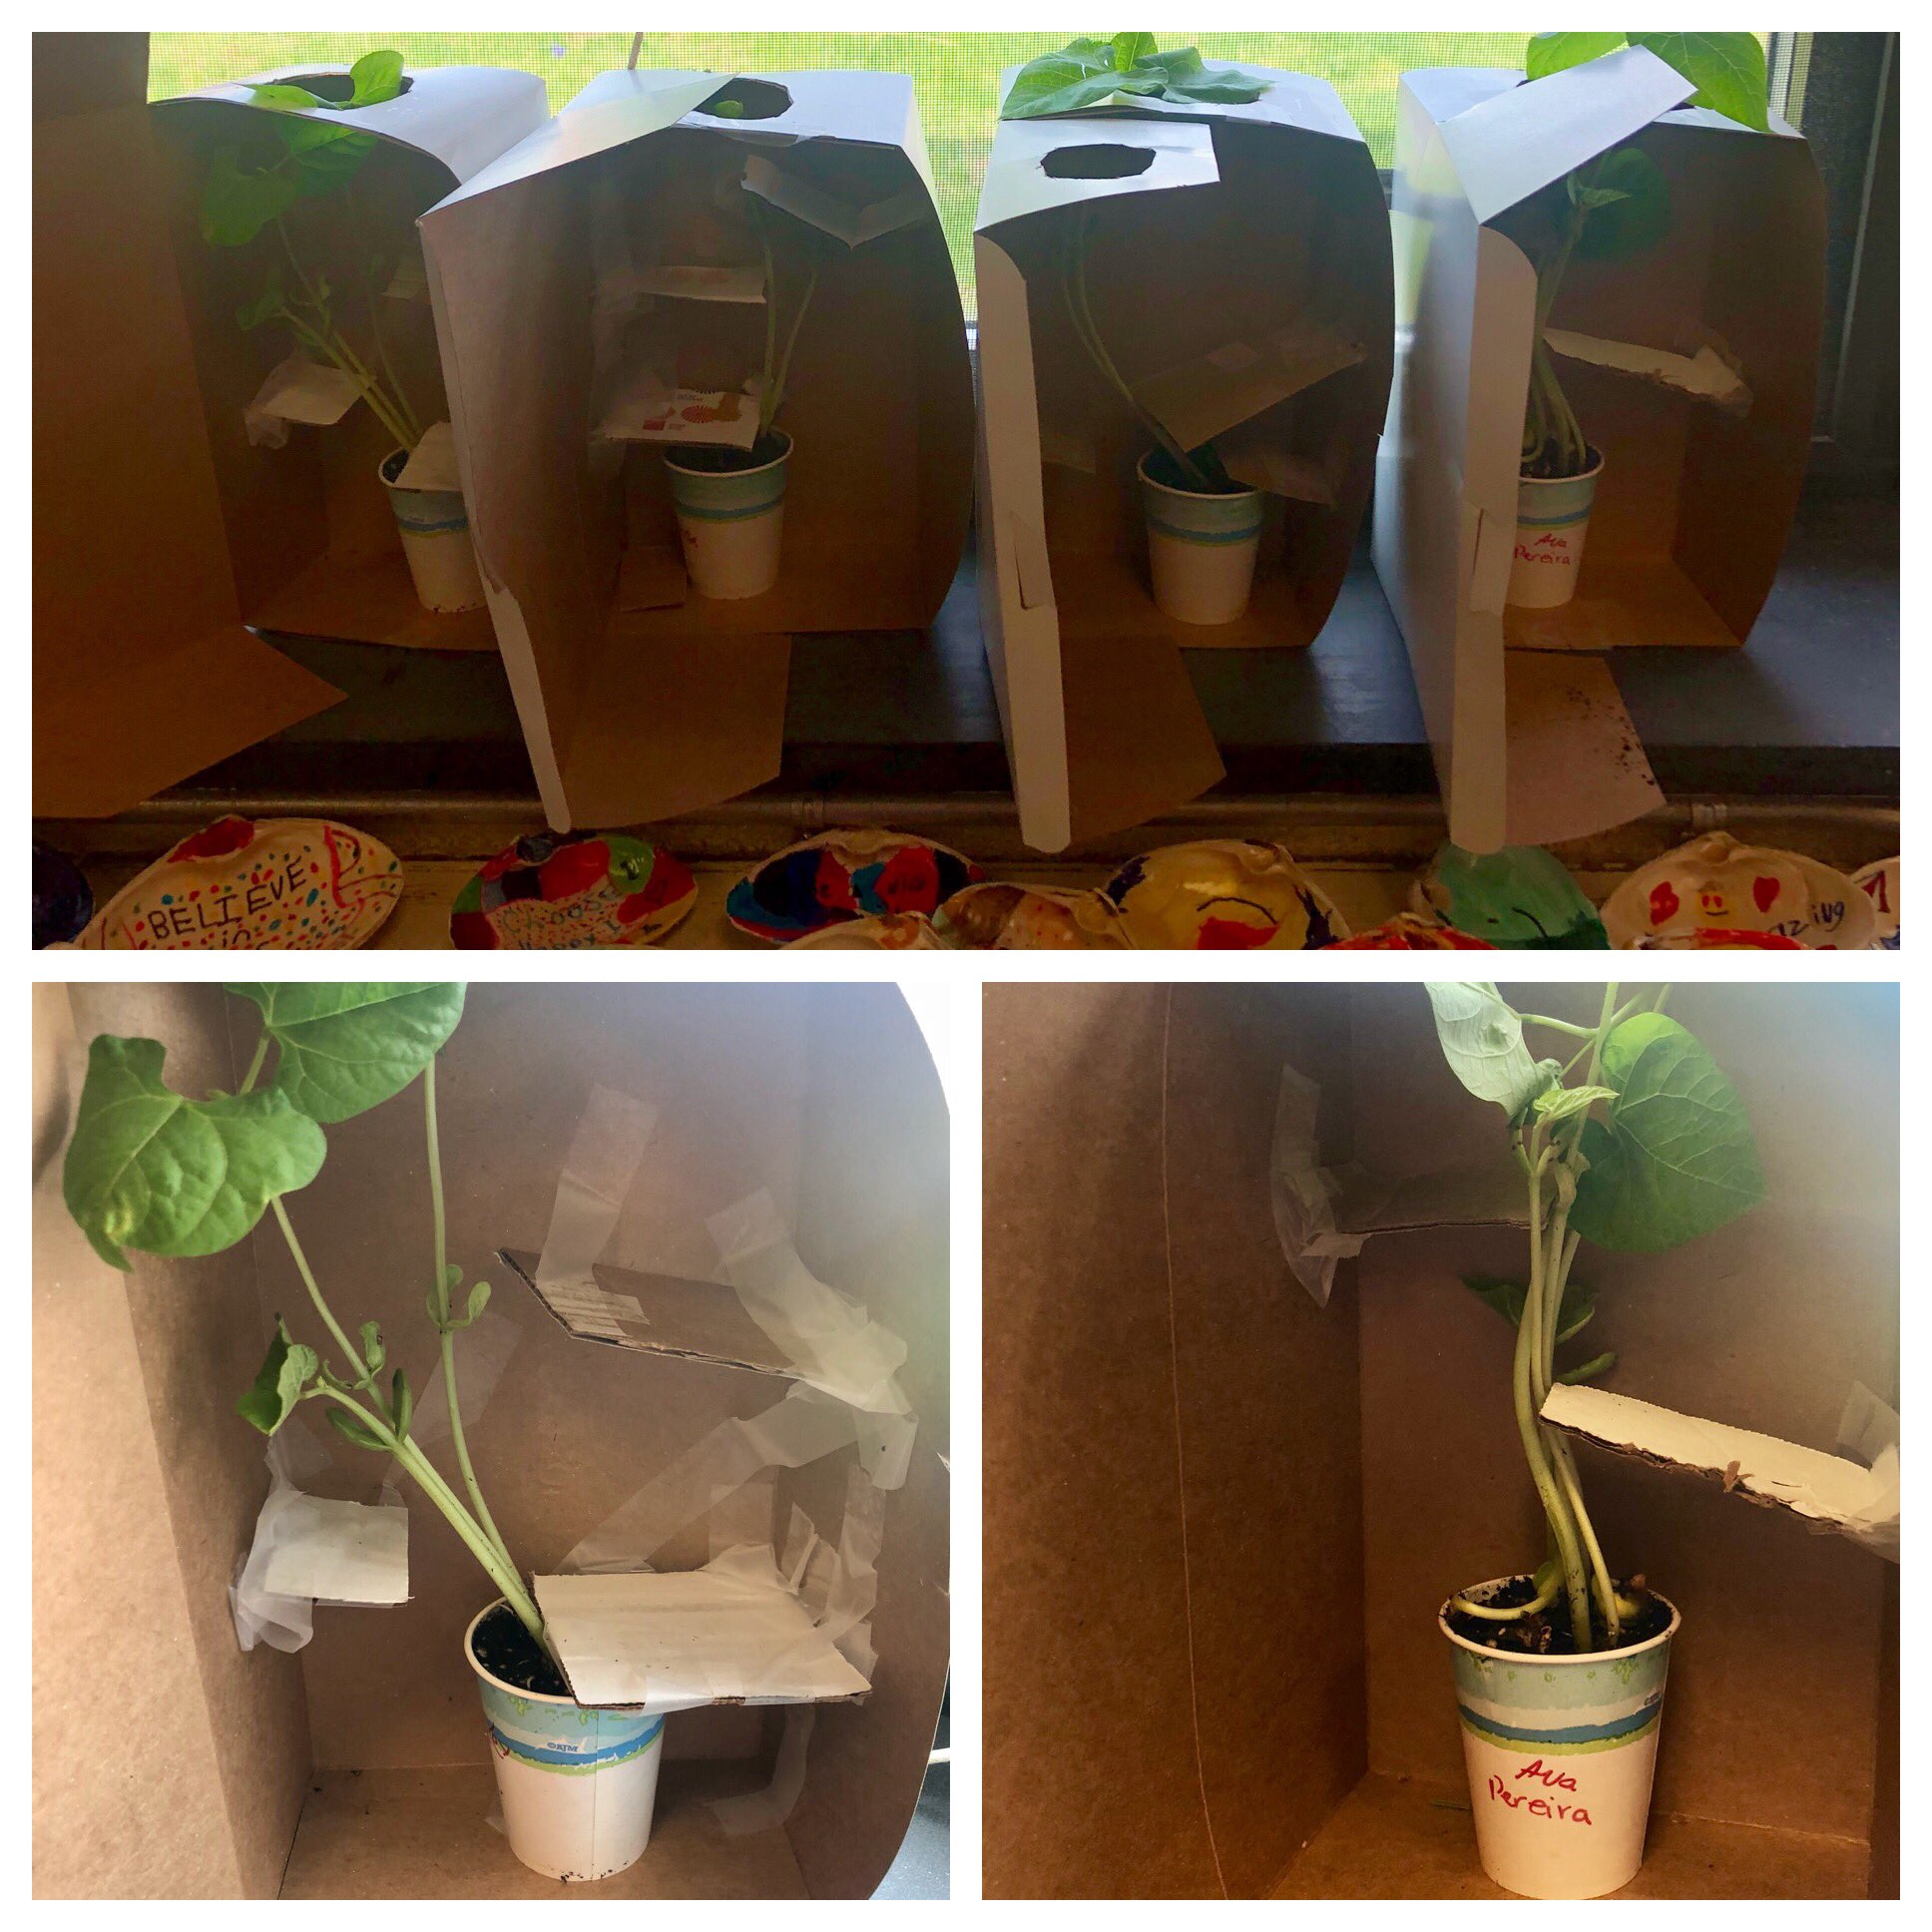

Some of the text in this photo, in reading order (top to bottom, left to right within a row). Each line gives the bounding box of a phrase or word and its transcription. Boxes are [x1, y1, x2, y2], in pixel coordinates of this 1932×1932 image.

[148, 855, 308, 940] BELIEVE
[1488, 1774, 1593, 1826] Pereira
[1514, 1759, 1578, 1792] Ava
